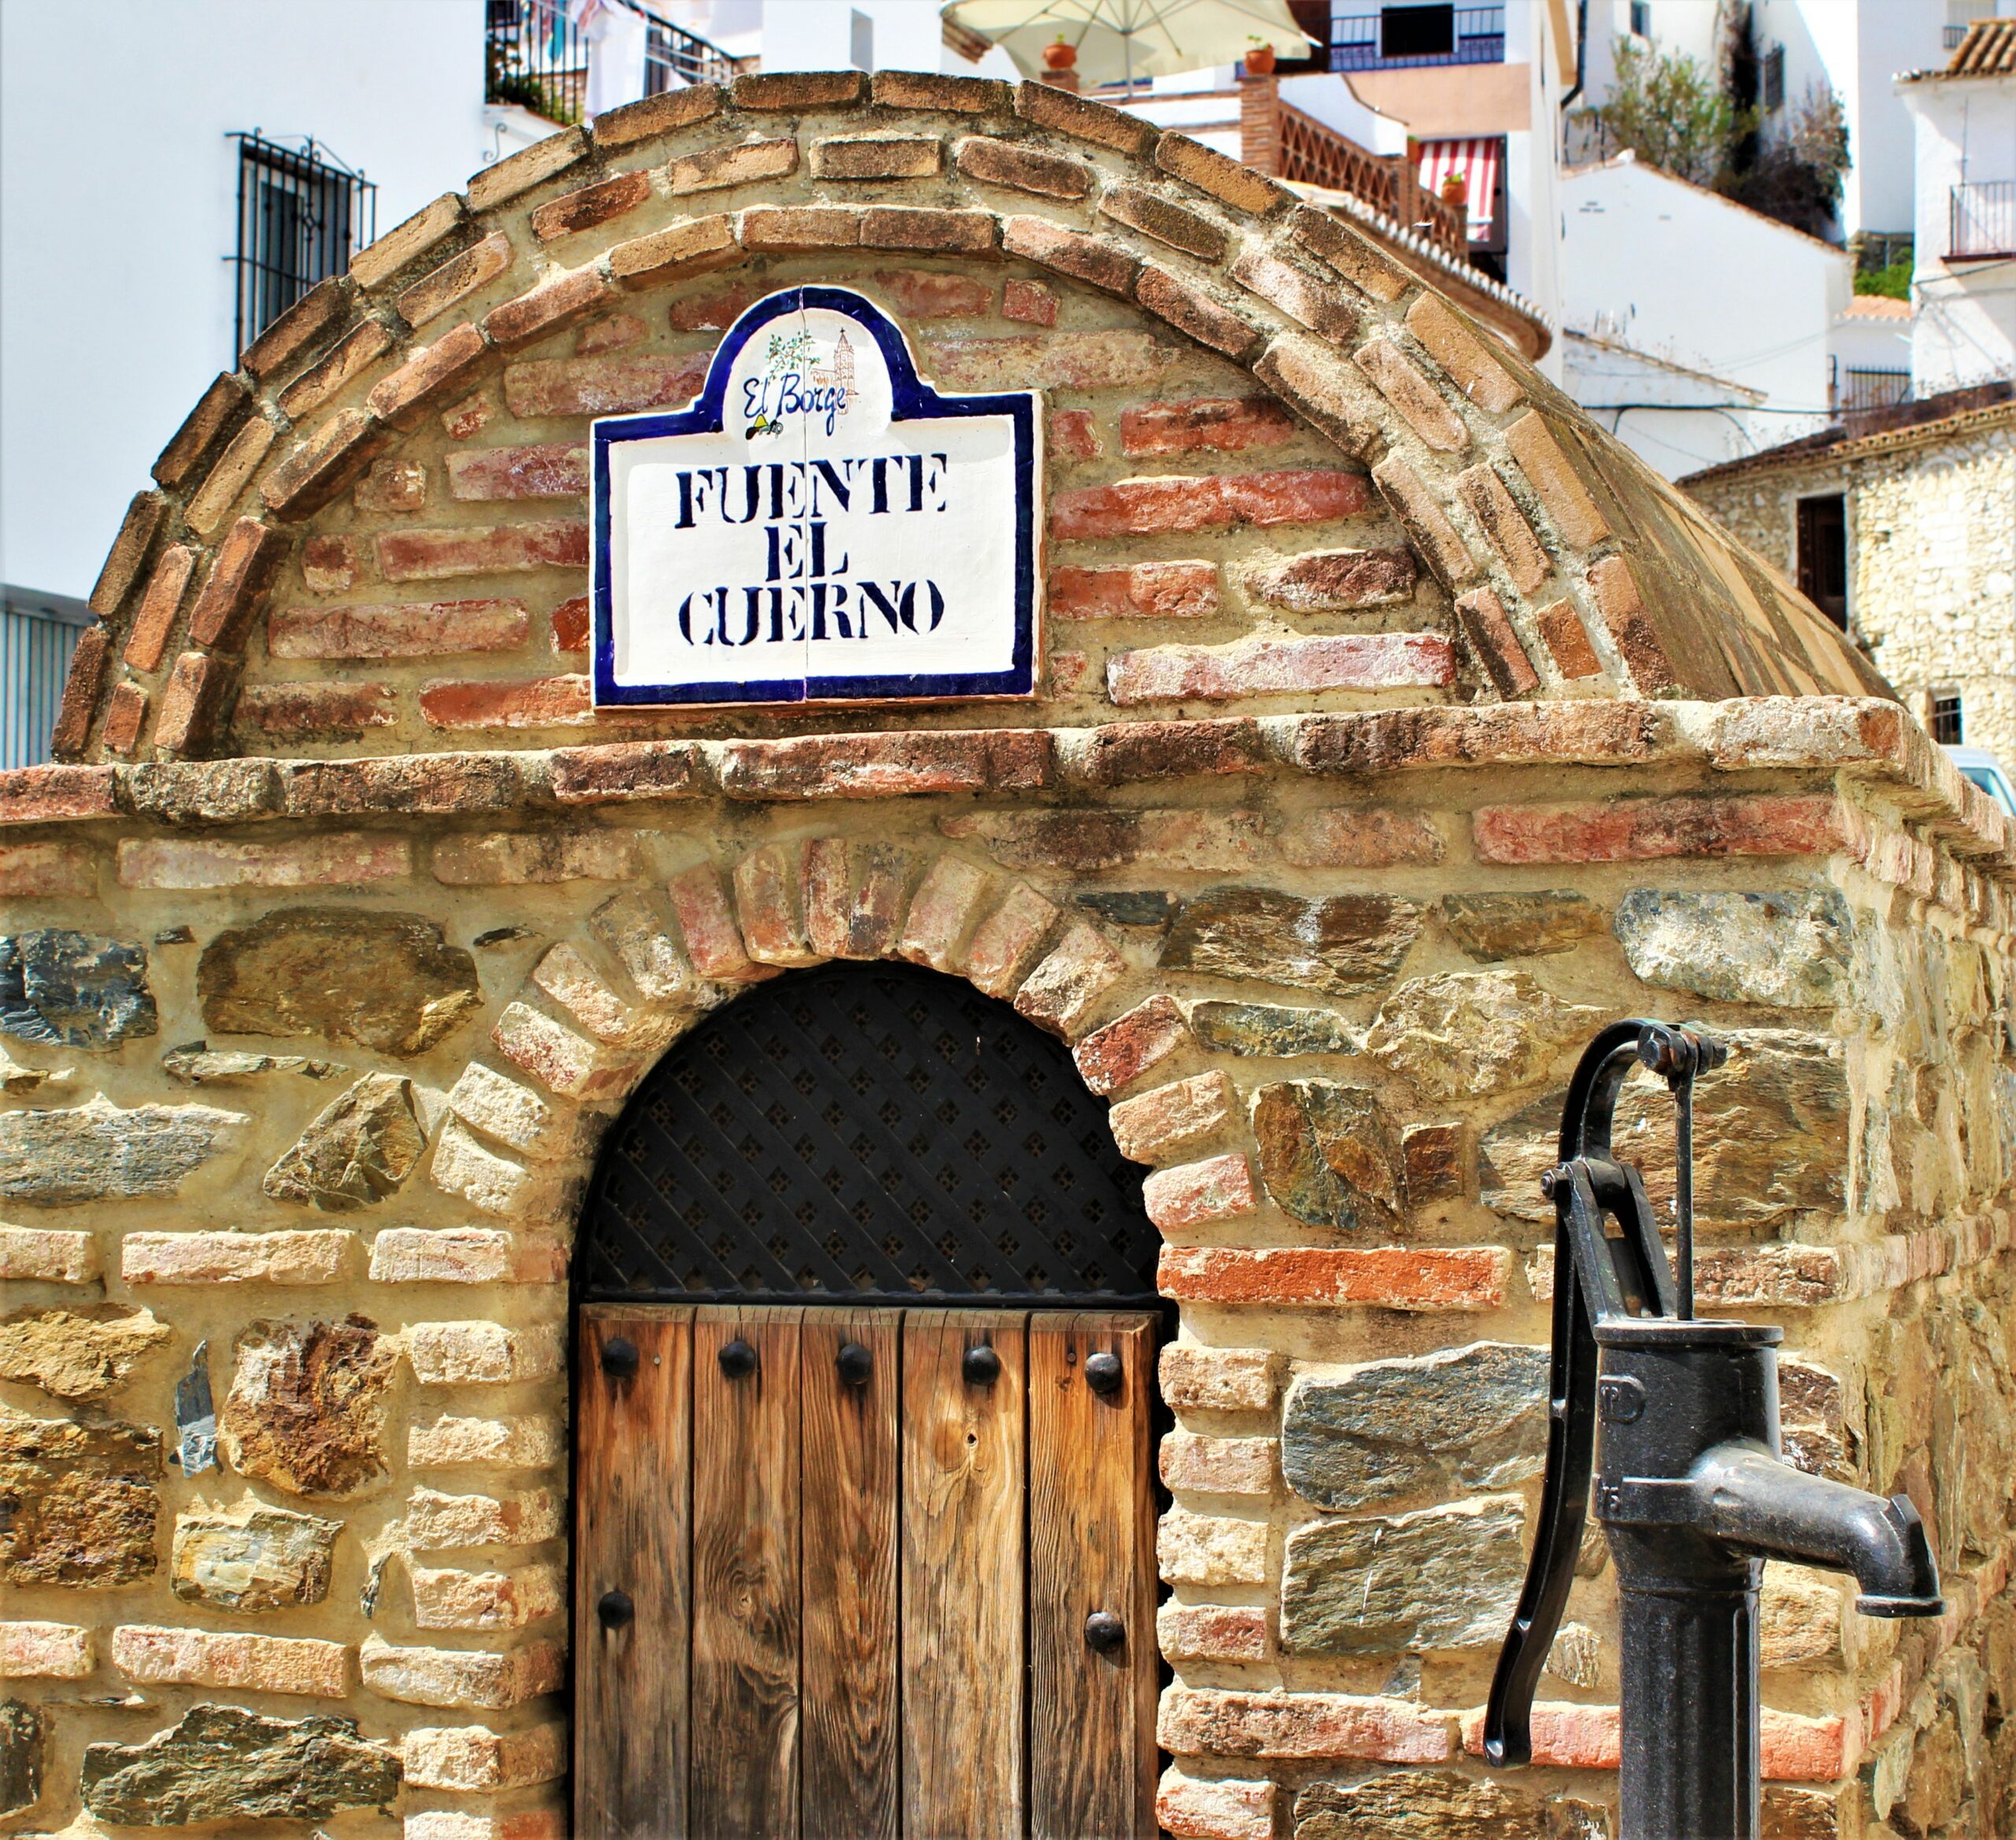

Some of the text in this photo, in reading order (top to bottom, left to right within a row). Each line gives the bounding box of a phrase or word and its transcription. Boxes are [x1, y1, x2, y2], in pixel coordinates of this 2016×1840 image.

[743, 372, 847, 437] El Borge
[674, 453, 947, 529] FUENTE
[764, 520, 849, 583] EL
[678, 579, 946, 647] CUERNO
